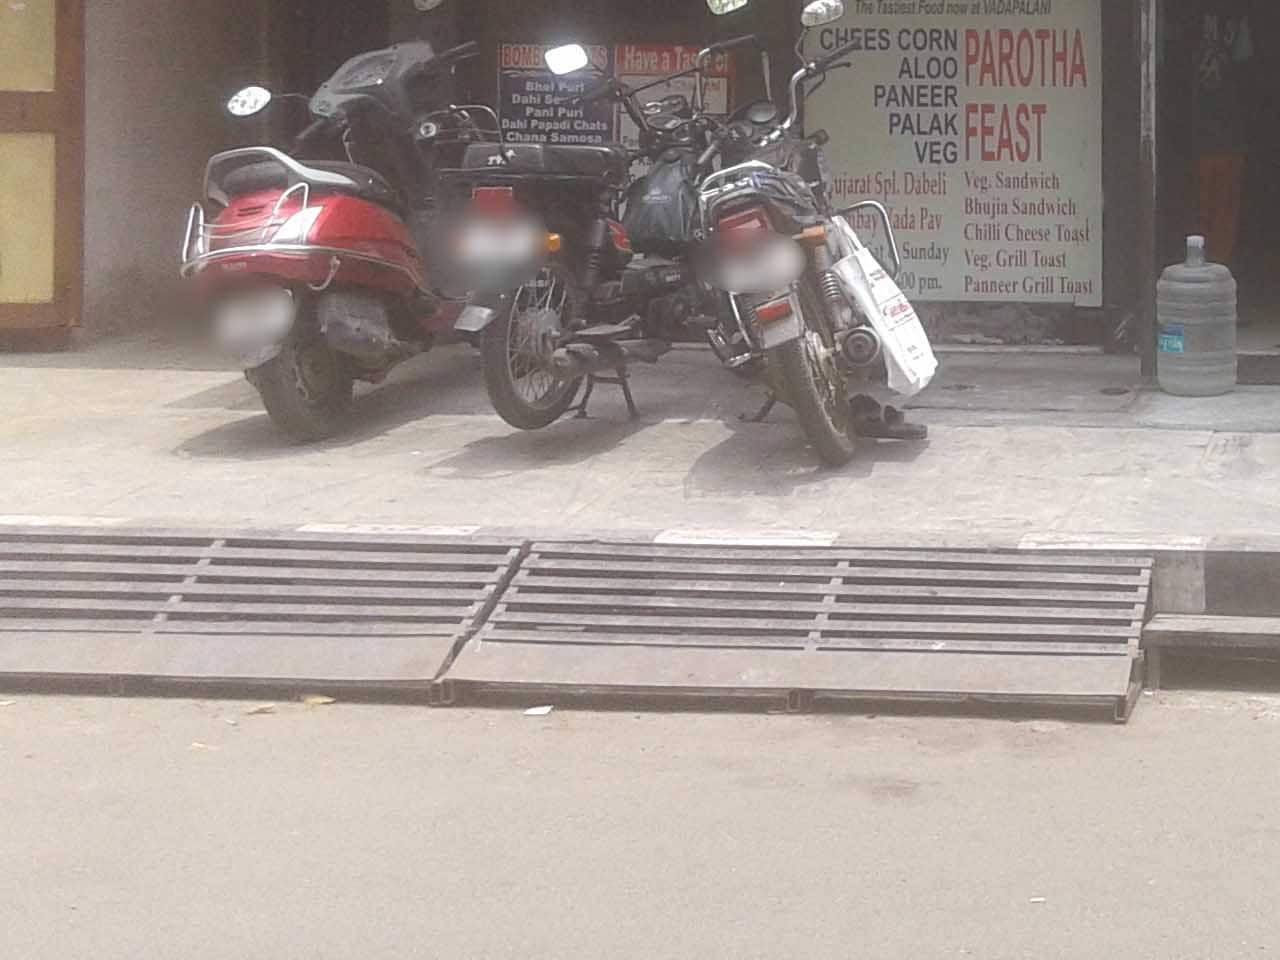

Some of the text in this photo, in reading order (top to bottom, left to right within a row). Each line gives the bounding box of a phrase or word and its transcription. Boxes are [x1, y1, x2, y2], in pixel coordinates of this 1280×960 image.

[855, 0, 873, 15] The
[918, 0, 946, 15] Food
[983, 0, 1052, 15] VADAPALANI
[898, 28, 958, 50] CORN
[624, 46, 659, 70] Have
[676, 46, 709, 70] Tase
[899, 58, 958, 79] ALOO
[965, 28, 1087, 87] PAROTHA
[512, 93, 541, 105] Dahi
[874, 85, 958, 107] PANEER
[525, 106, 554, 117] Pani
[502, 120, 527, 130] Dahi
[573, 120, 608, 131] Chats
[889, 112, 958, 135] PALAK
[965, 103, 1047, 162] FEAST
[506, 132, 602, 143] Chana Samosa
[915, 141, 958, 164] VEG
[830, 172, 874, 199] ujarat
[904, 171, 946, 196] Dabeli
[964, 170, 1060, 192] Veg. Sandwich
[964, 197, 1076, 218] Bhujia Sandwich
[920, 207, 944, 231] Pav
[964, 223, 1090, 242] Chilli Cheese Toast
[902, 241, 951, 267] Sunday
[964, 249, 1066, 271] Veg. Grill Toast
[919, 276, 943, 295] pm.
[964, 275, 1093, 295] Panneer Grill Toast
